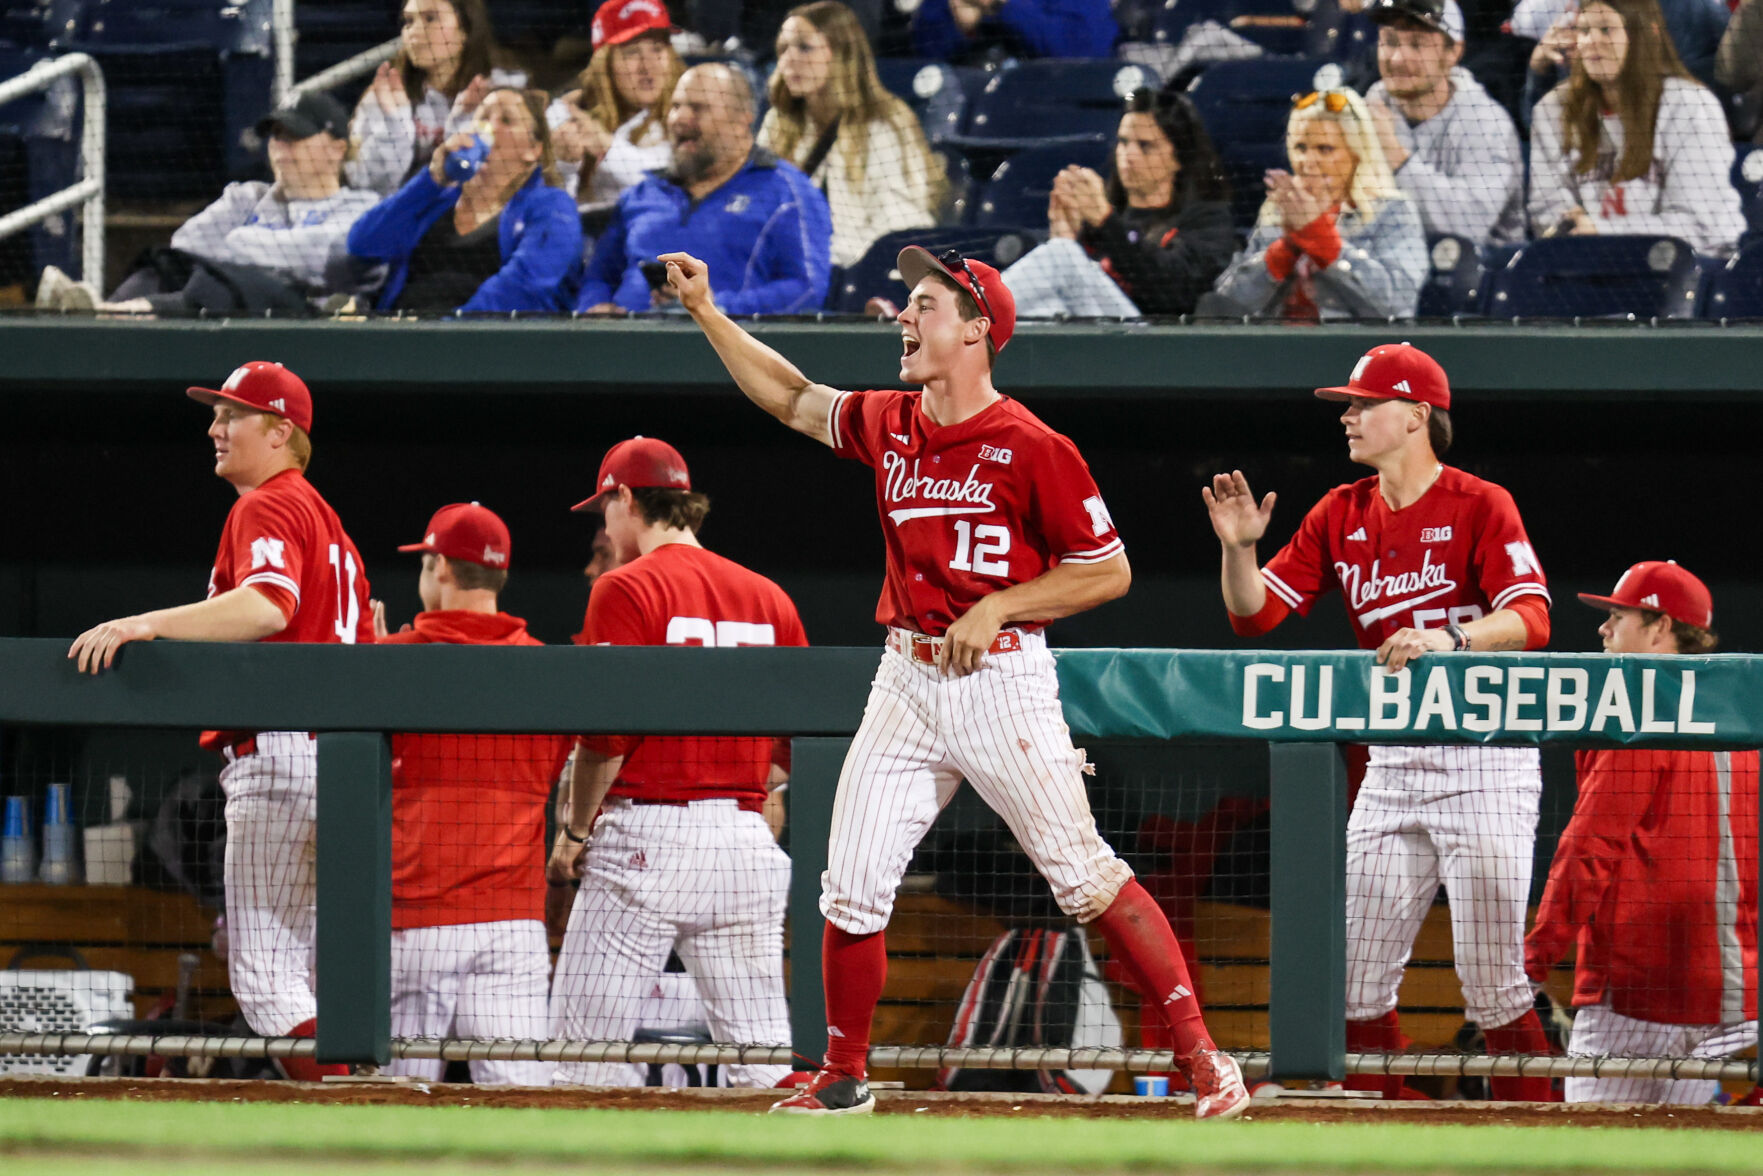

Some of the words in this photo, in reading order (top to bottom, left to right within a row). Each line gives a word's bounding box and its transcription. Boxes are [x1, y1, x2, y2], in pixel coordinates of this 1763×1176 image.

[250, 536, 285, 570] N
[949, 519, 1011, 577] 12
[1504, 541, 1542, 577] N
[1334, 549, 1450, 610] Nebraska
[998, 635, 1012, 650] 12
